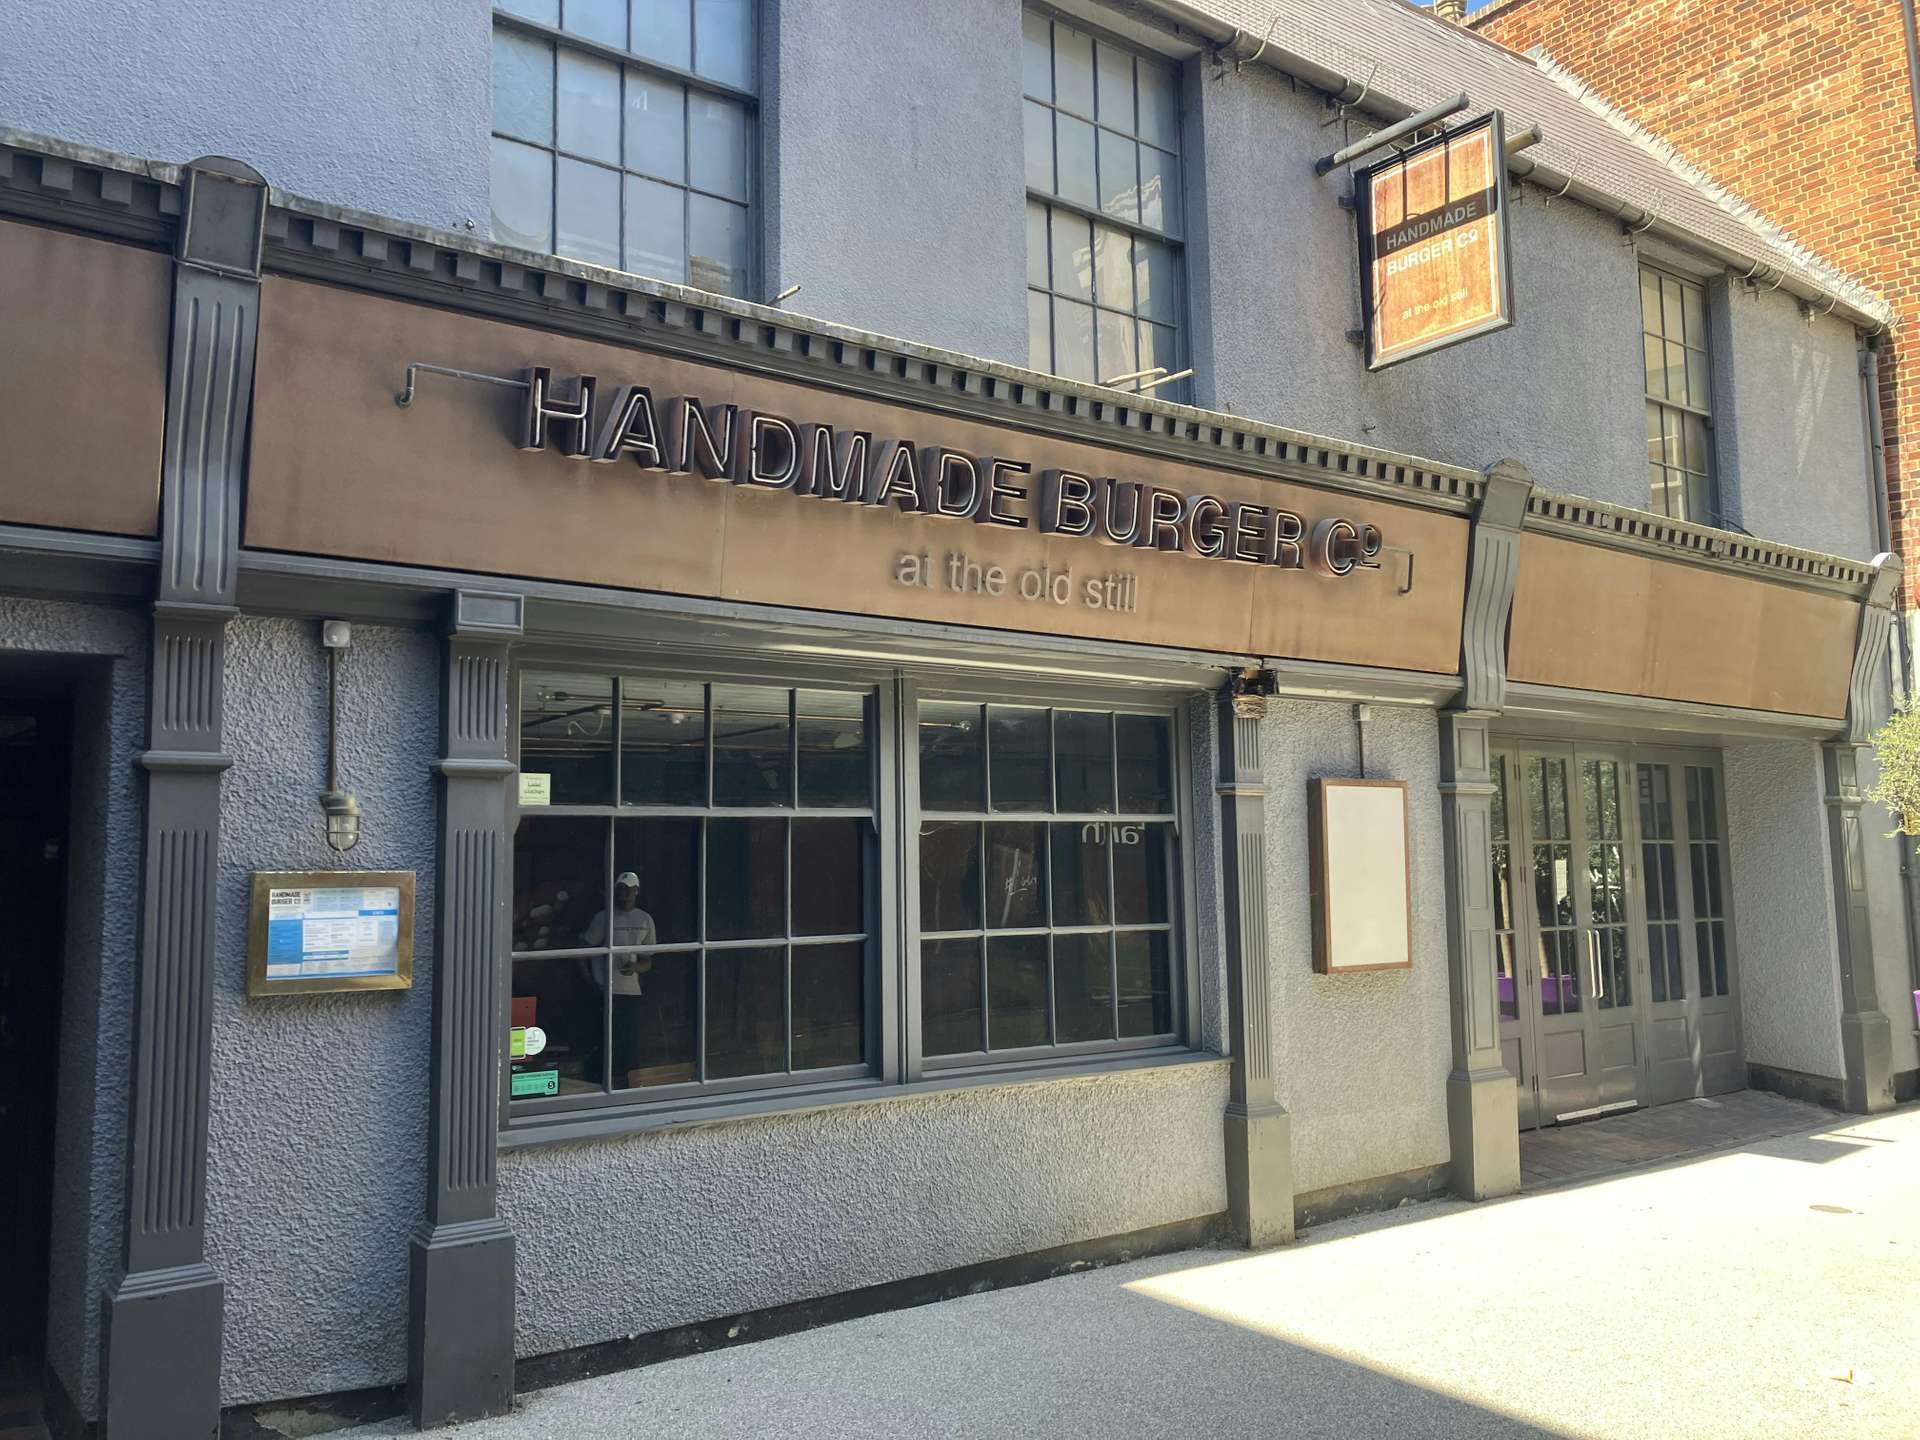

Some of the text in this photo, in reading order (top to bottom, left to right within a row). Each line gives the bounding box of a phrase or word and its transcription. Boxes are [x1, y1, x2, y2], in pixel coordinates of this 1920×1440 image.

[1386, 202, 1478, 250] HANDMADE
[1386, 239, 1454, 277] BURGER
[1402, 288, 1469, 320] at the old still
[519, 366, 1032, 529] HANDMADE
[1040, 468, 1307, 570] BURGER
[896, 551, 1139, 614] at the old still
